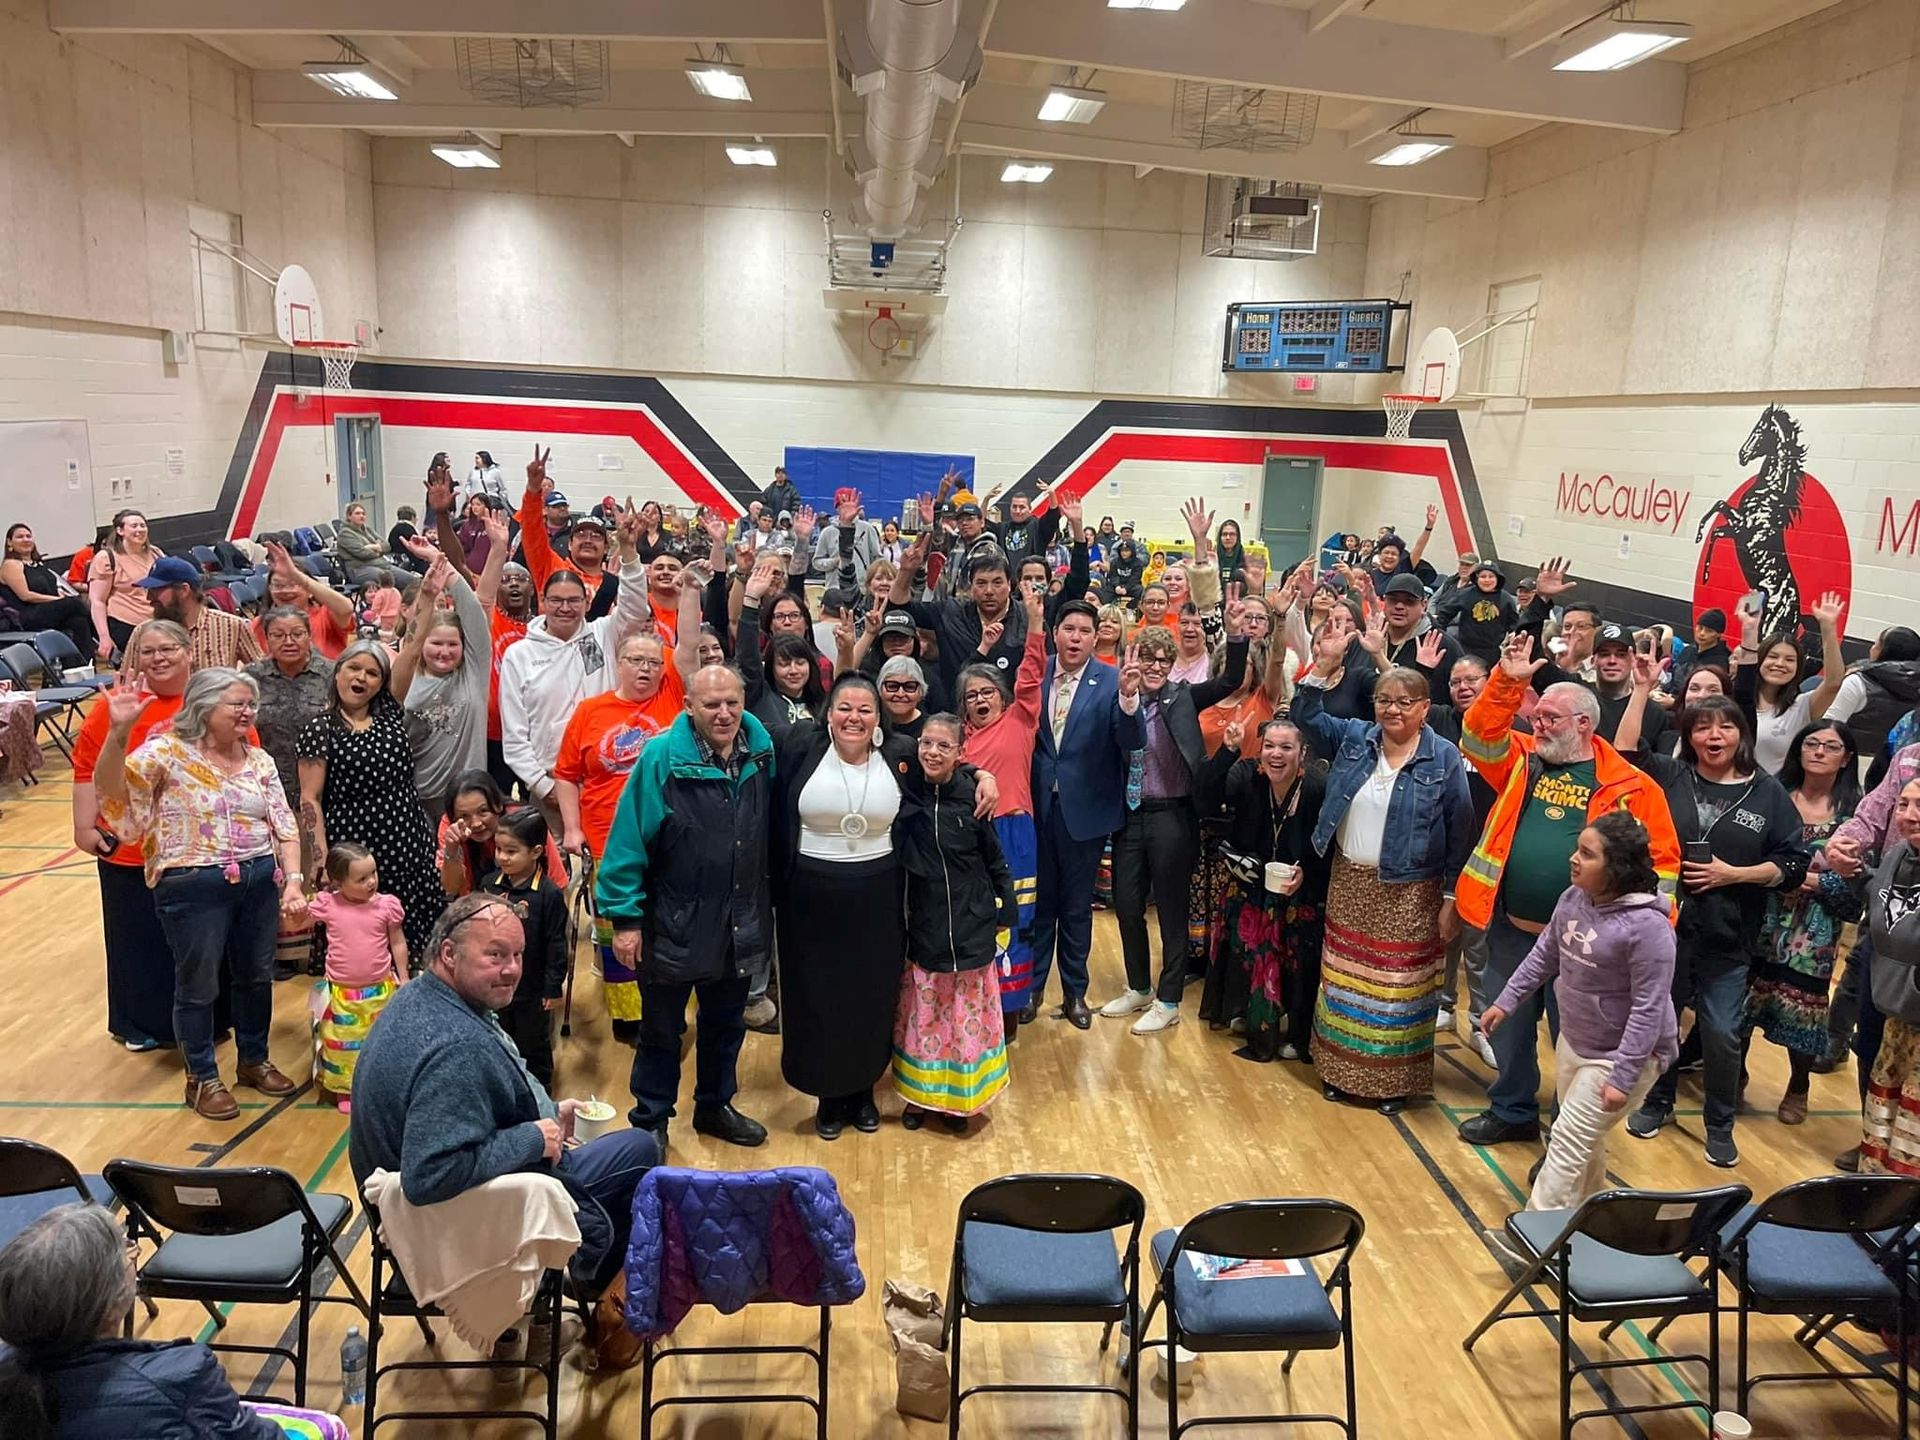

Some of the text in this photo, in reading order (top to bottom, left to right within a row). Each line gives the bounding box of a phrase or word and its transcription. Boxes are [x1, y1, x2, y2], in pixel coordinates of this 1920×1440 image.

[1246, 312, 1270, 324] Home
[1349, 311, 1381, 323] Guests
[1556, 472, 1691, 534] McCauley
